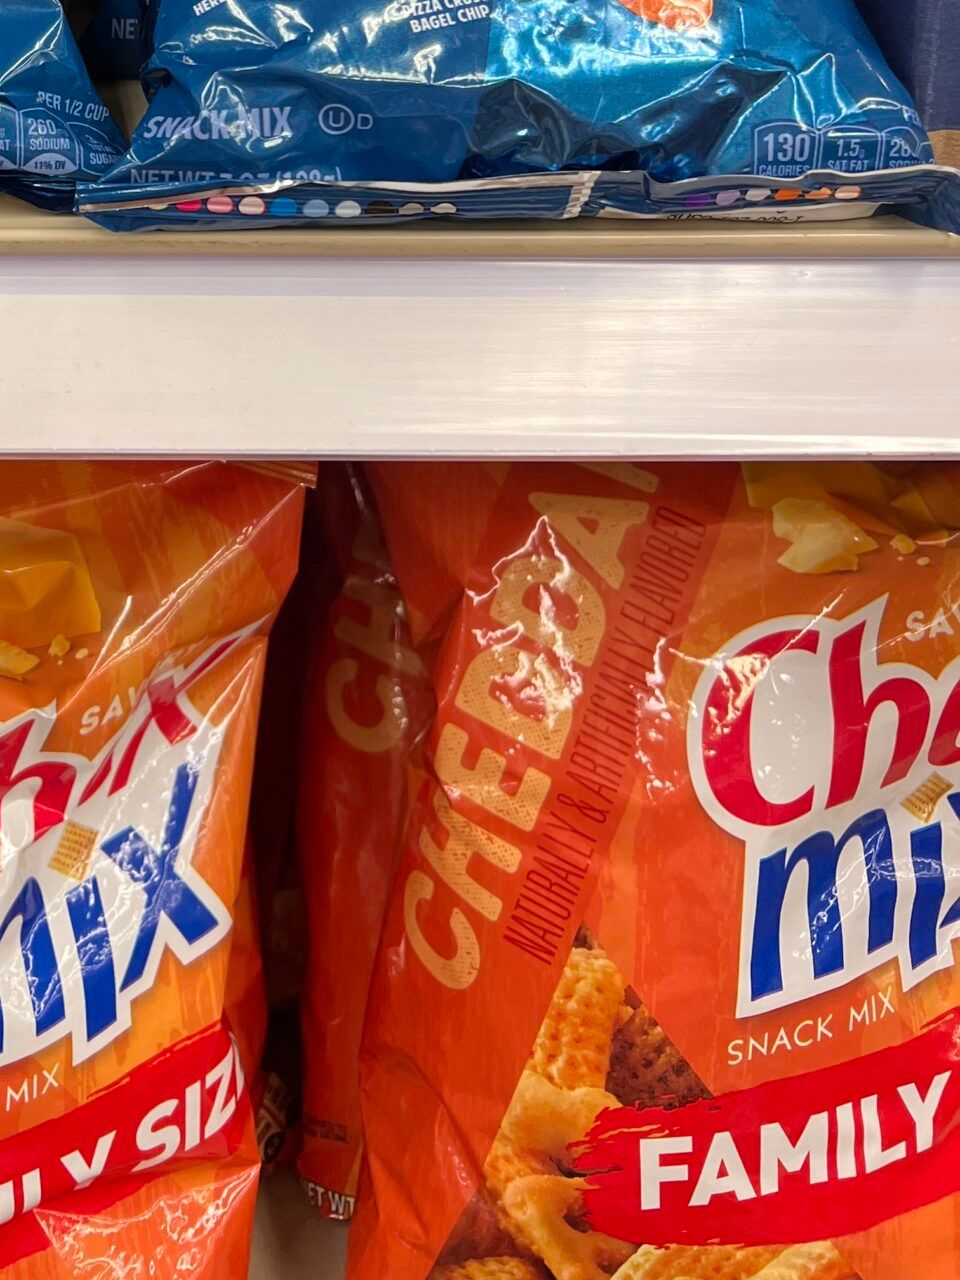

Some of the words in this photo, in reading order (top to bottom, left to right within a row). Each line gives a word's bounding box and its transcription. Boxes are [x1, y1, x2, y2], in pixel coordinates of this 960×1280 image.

[409, 13, 456, 33] BAGEL
[458, 5, 491, 23] CHIP
[37, 90, 62, 113] PER
[63, 98, 82, 118] 1/2
[83, 102, 110, 123] CUP
[143, 110, 225, 141] SNACK
[239, 106, 292, 139] MIX
[29, 138, 71, 151] SODIUM
[763, 132, 811, 163] 130
[54, 160, 67, 170] DV
[759, 164, 810, 177] CALORIES
[827, 159, 846, 172] SAT
[849, 159, 869, 172] FAT
[616, 504, 709, 640] FLAVORED
[565, 631, 647, 794] ARTIFICIALLY
[572, 789, 609, 824] &
[502, 818, 600, 967] NATURALLY
[726, 1013, 833, 1066] SNACK
[847, 985, 896, 1032] MIX
[5, 1061, 61, 1112] MIX
[638, 1070, 953, 1211] FAMILY
